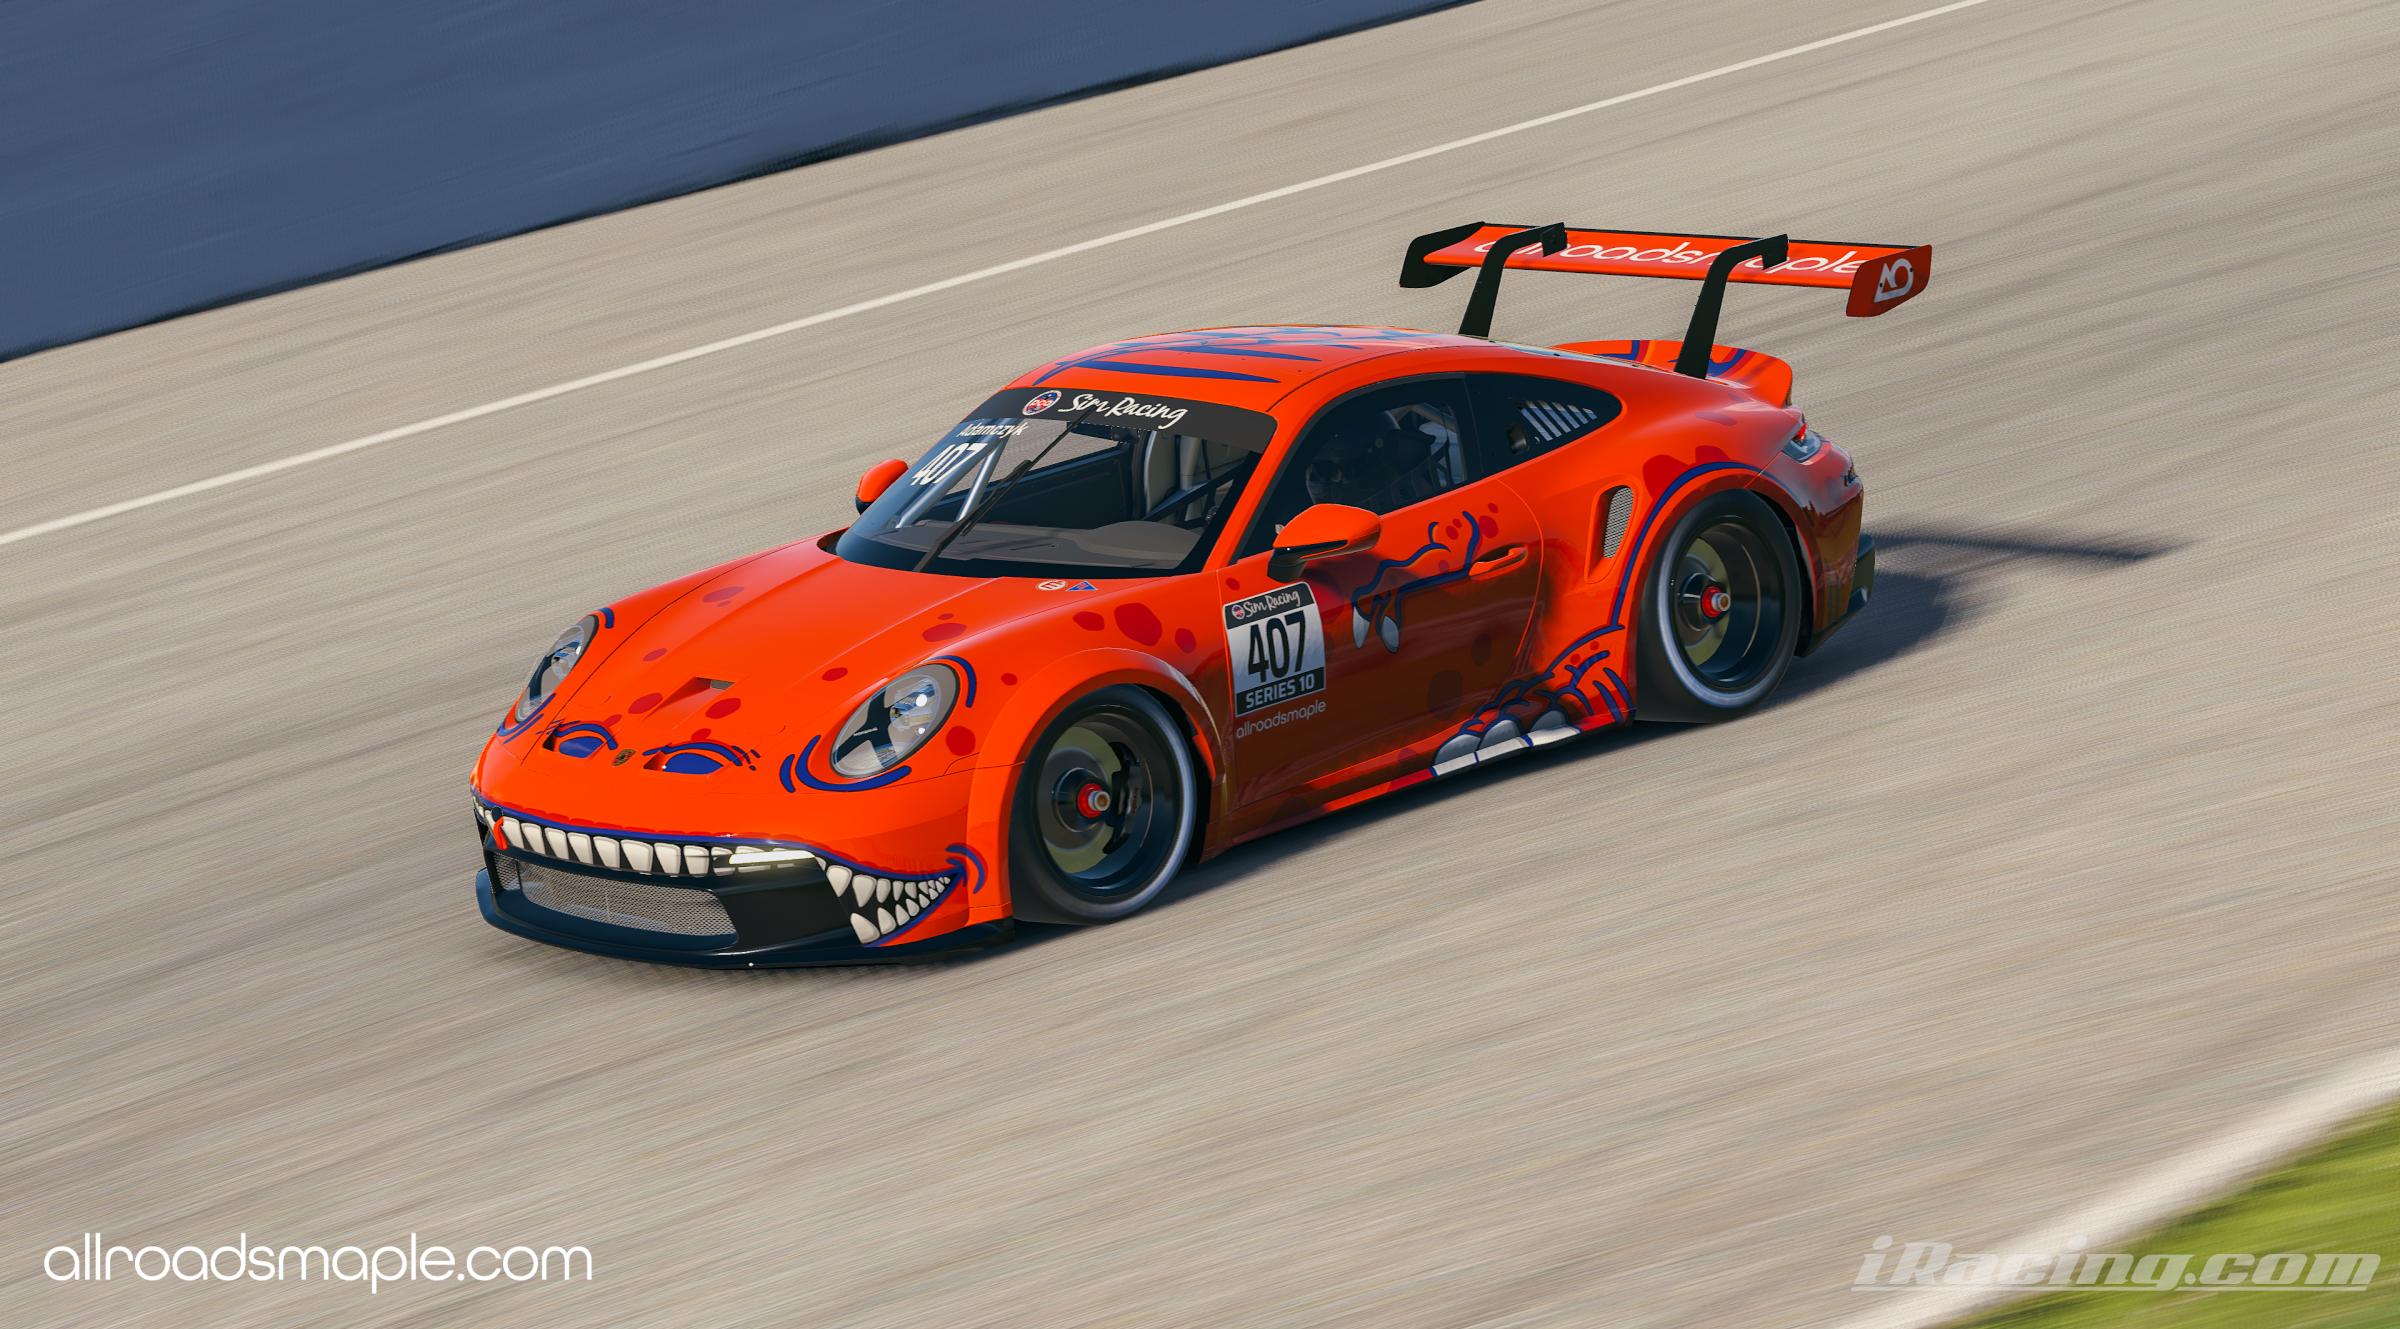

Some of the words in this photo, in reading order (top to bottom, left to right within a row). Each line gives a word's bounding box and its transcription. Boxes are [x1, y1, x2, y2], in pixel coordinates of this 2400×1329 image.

[1058, 393, 1110, 413] Sim
[1104, 397, 1188, 430] Racing
[955, 422, 1029, 439] Adamczyk
[910, 443, 988, 486] 407
[1243, 601, 1267, 618] Sim
[1264, 591, 1300, 611] Racing
[1248, 610, 1306, 683] 407
[1246, 680, 1296, 709] SERIES
[1300, 673, 1315, 692] 10
[1236, 700, 1327, 739] allroadsmaple
